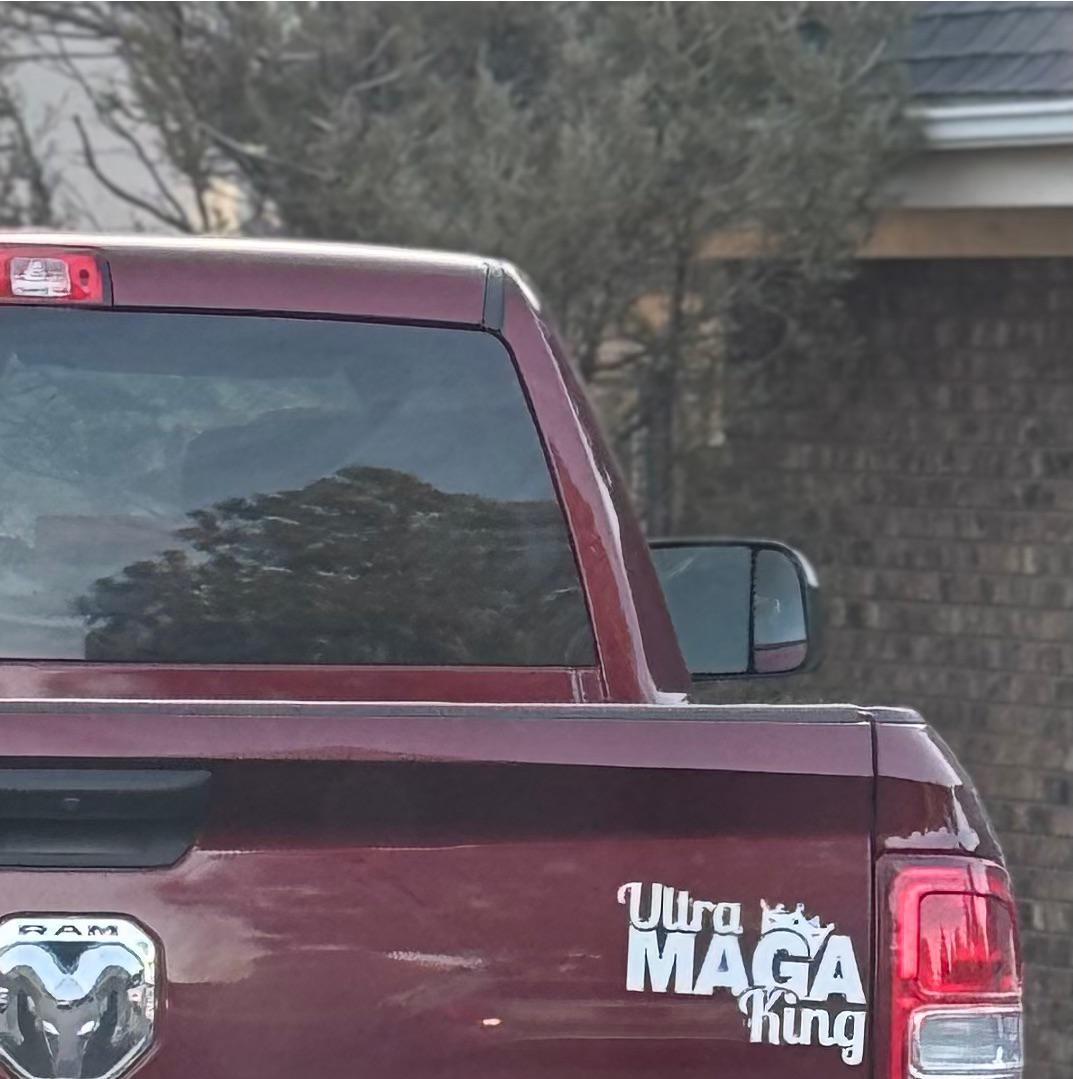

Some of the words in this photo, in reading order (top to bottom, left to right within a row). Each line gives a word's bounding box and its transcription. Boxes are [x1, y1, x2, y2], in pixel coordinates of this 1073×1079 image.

[18, 925, 118, 936] RAM
[616, 881, 744, 933] Ultra
[625, 925, 867, 1004] MAGA
[738, 987, 867, 1066] King
